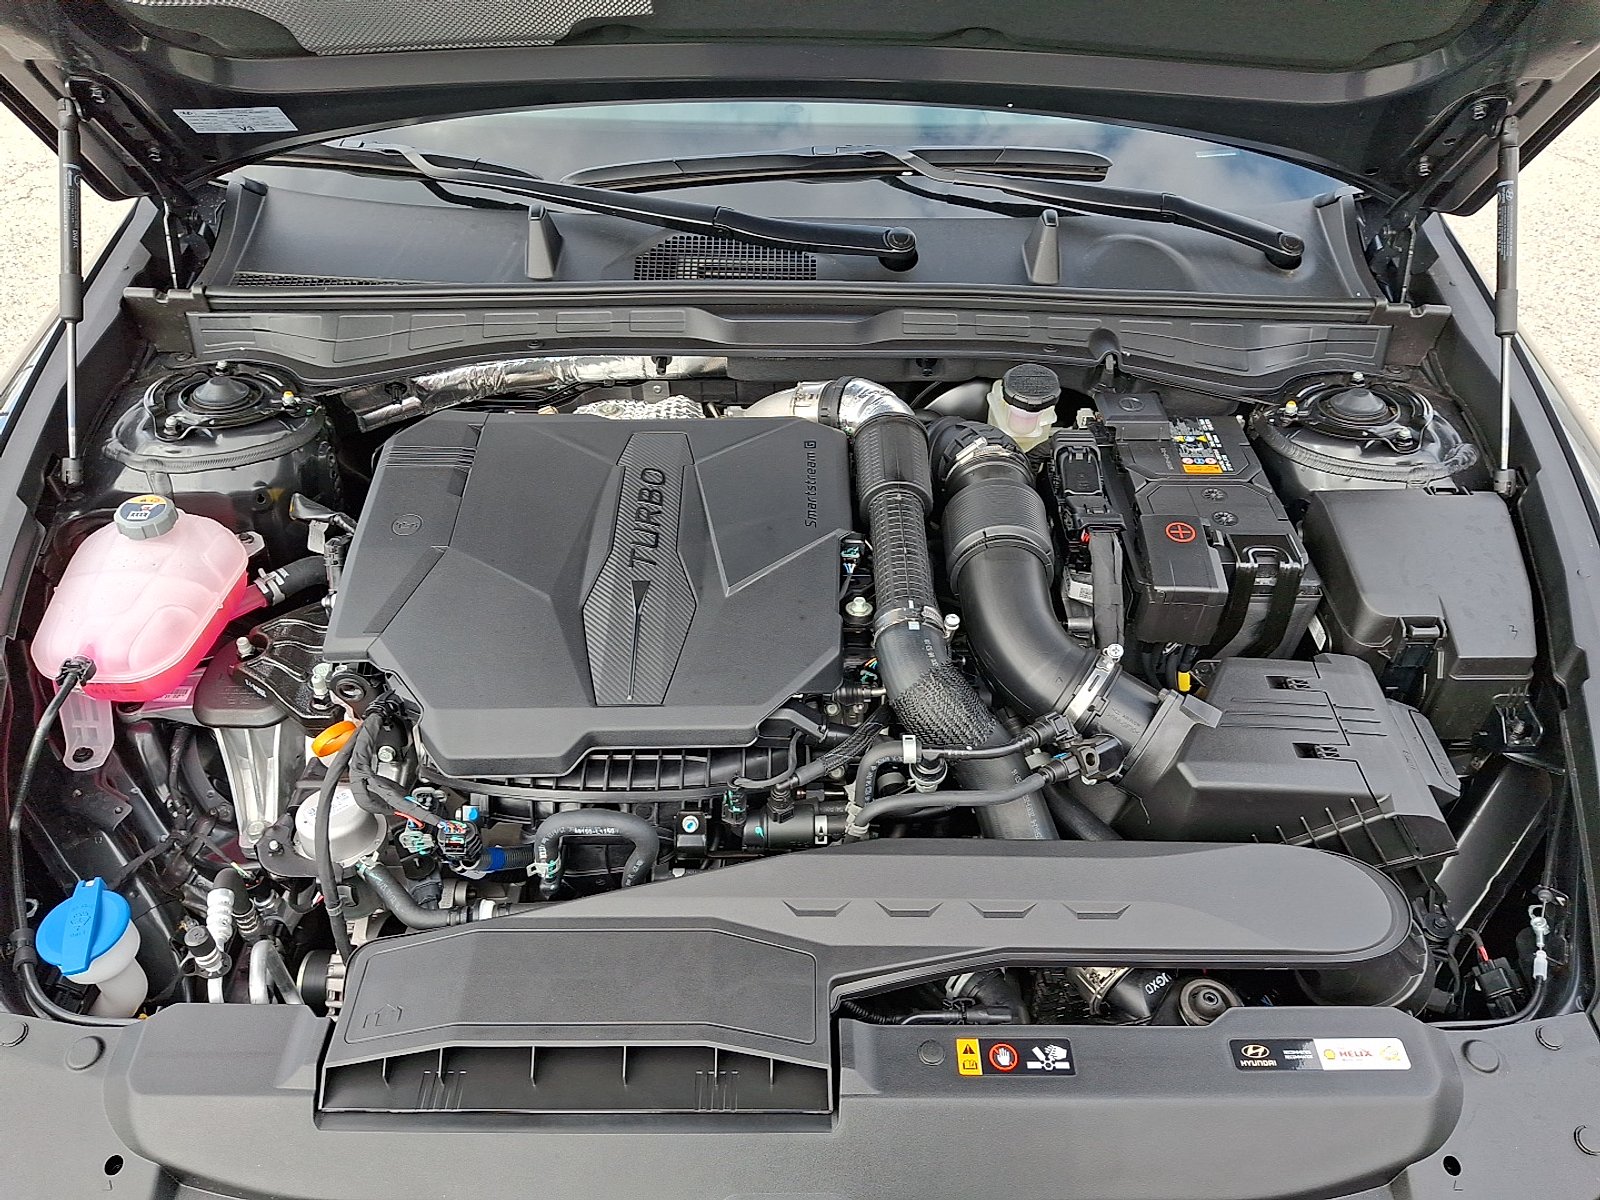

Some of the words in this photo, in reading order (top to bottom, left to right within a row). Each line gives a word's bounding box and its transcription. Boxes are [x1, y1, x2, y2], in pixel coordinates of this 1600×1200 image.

[804, 450, 817, 529] Smartstream
[628, 467, 666, 569] TURBO
[1239, 1059, 1278, 1067] HYUNDAI
[1338, 1050, 1374, 1058] HELIX
